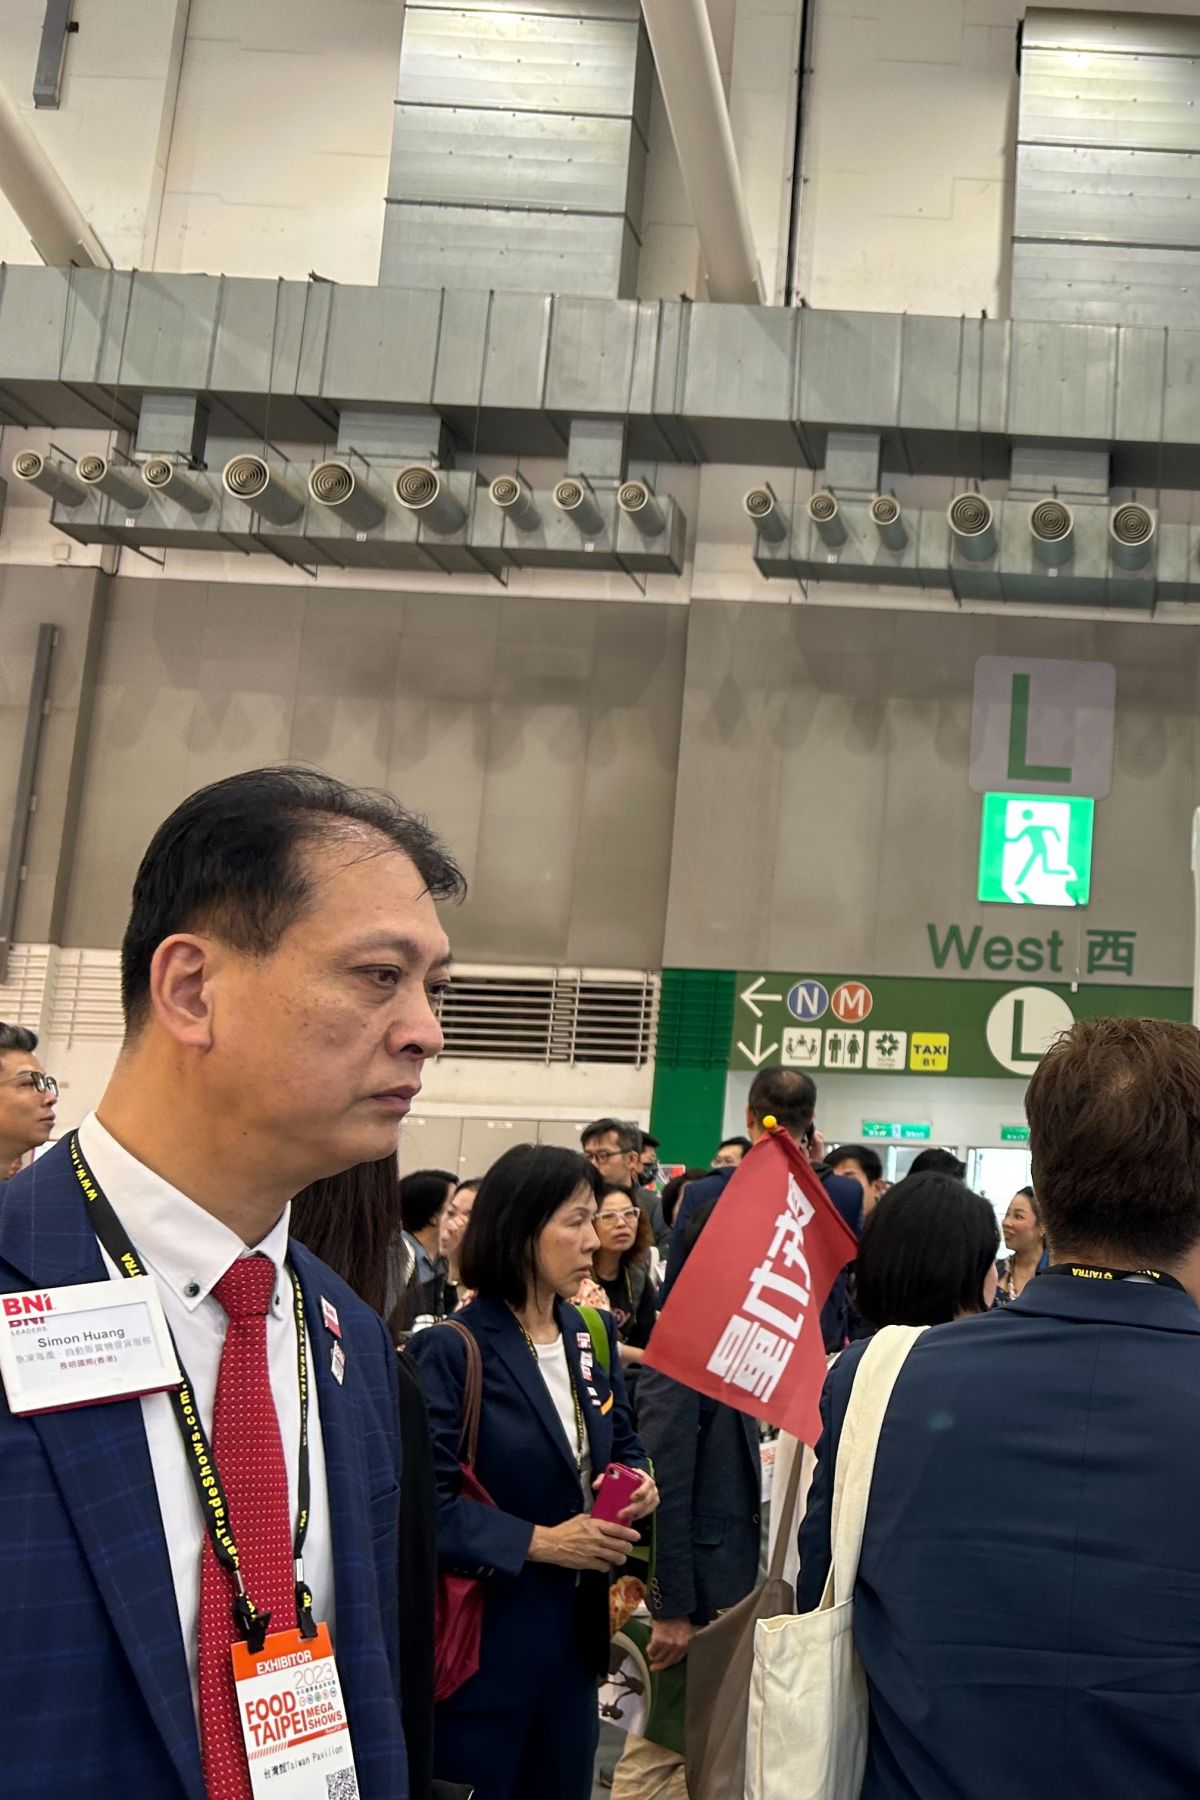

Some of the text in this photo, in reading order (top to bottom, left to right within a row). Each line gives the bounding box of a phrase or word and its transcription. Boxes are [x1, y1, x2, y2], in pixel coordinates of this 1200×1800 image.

[1007, 673, 1072, 783] L
[927, 923, 1137, 975] West 西
[796, 986, 865, 1017] N M
[1011, 1000, 1046, 1062] L
[914, 1044, 947, 1056] TAXI
[11, 1326, 48, 1337] LEADERS
[37, 1328, 126, 1348] Simon Huang
[256, 1650, 313, 1674] EXHIBITOR
[293, 1662, 335, 1690] 2023
[245, 1690, 297, 1725] FOOD
[306, 1701, 334, 1718] MEGA
[308, 1710, 343, 1730] SHOWS
[249, 1709, 309, 1748] TAIPEI
[312, 1746, 343, 1762] Pavilion
